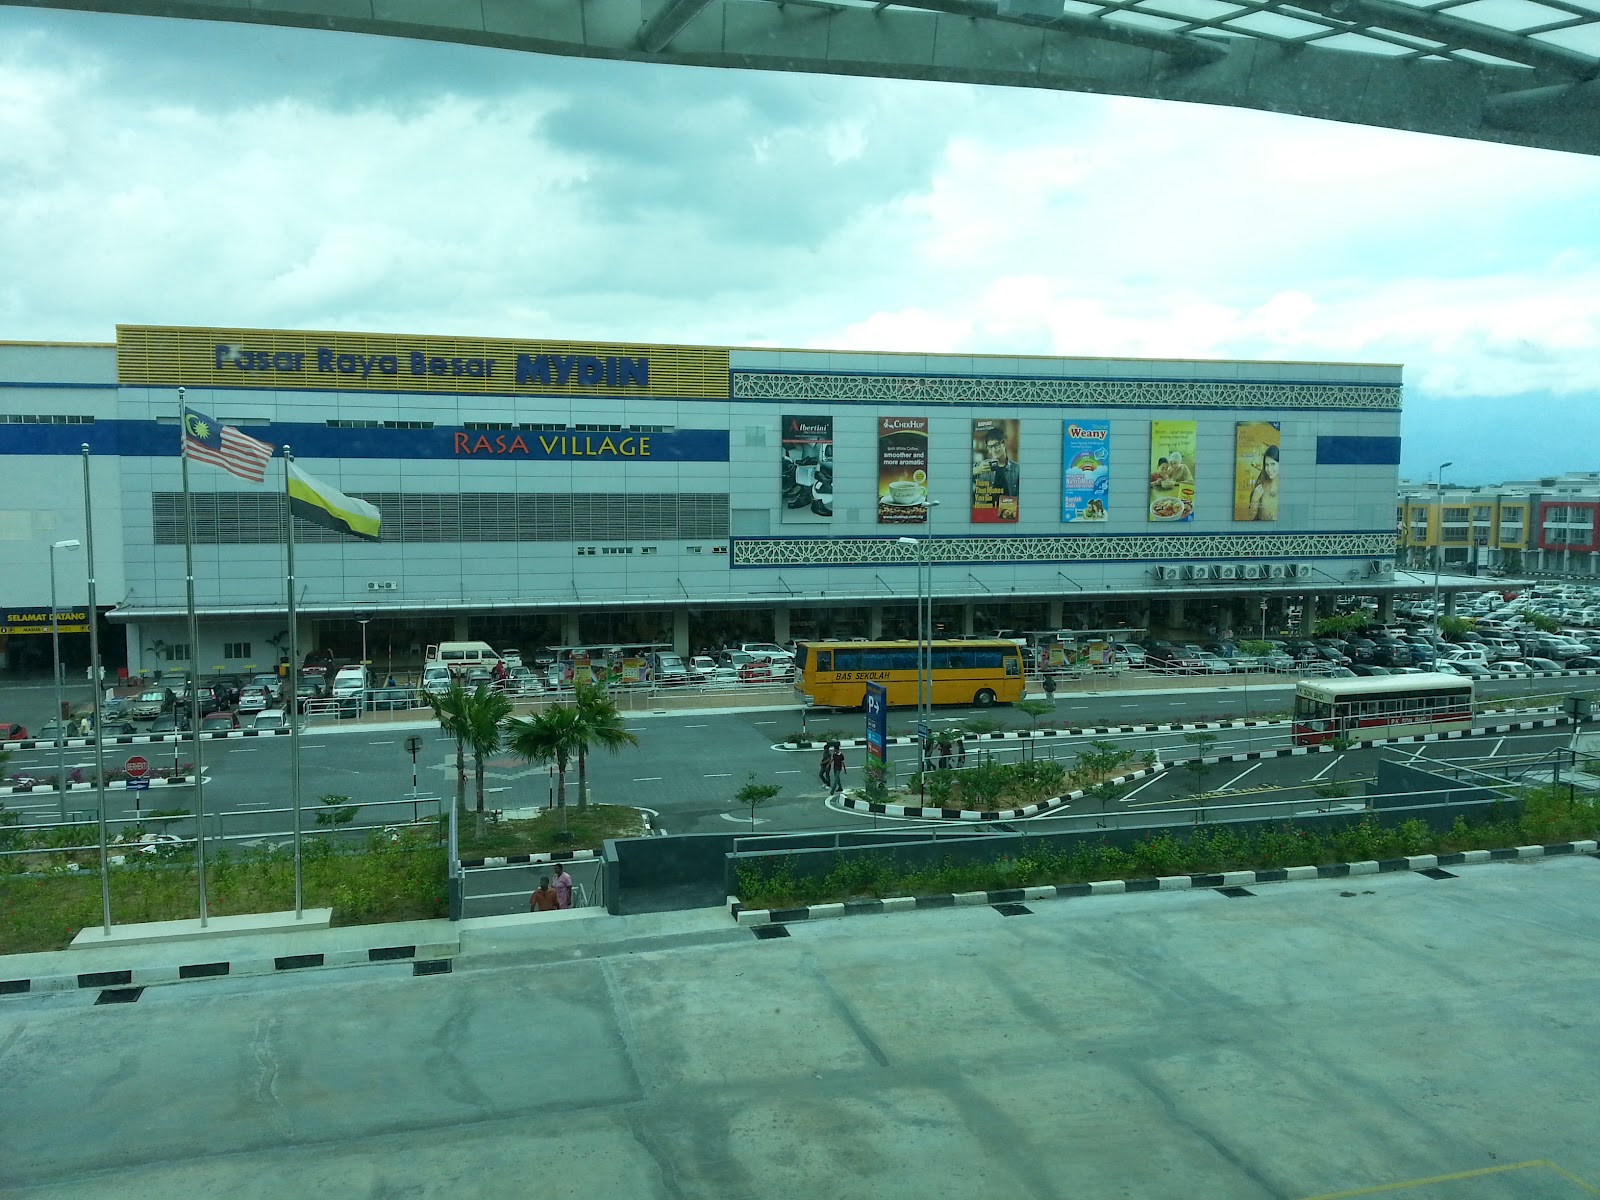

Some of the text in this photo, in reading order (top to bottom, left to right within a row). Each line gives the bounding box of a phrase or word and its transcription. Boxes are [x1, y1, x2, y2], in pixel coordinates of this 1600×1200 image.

[215, 344, 649, 387] Pasar Raya Besar MYDIN
[790, 419, 828, 432] Albertini
[1071, 428, 1106, 440] Weany
[454, 431, 651, 457] RASA VILLAGE
[7, 613, 86, 622] SELAMAT DATANG
[855, 672, 890, 680] SEKOLAH
[868, 696, 874, 713] P
